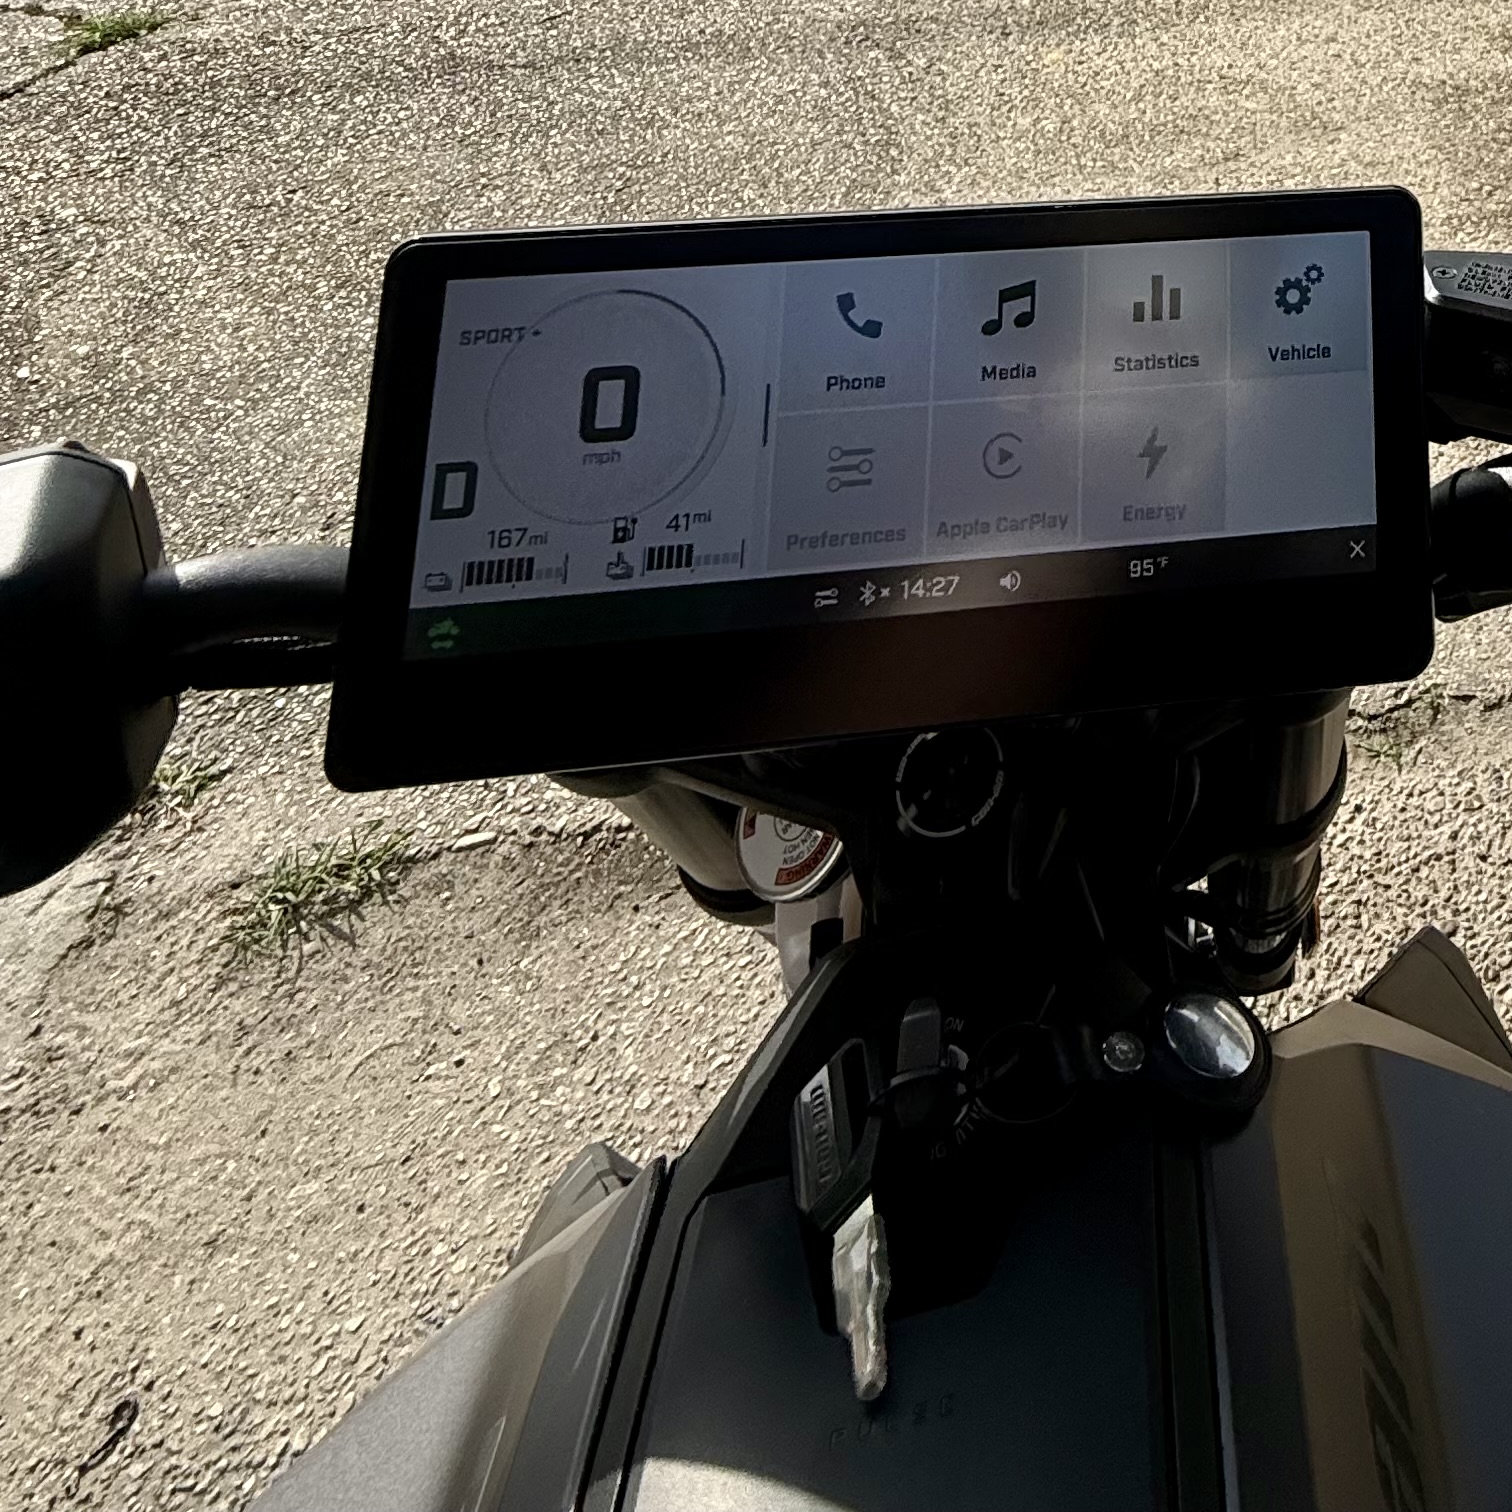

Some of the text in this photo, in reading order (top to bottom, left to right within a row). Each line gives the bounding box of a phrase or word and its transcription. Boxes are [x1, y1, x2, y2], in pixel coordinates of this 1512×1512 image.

[1113, 352, 1200, 372] Statistics
[1267, 343, 1332, 362] Vehicle
[980, 362, 1037, 381] Media
[826, 373, 886, 391] Phone
[579, 365, 641, 443] 0
[582, 449, 622, 466] mph
[429, 460, 479, 521] D
[1123, 503, 1187, 524] Energy
[936, 511, 1069, 540] Apple CarPlay
[786, 526, 907, 551] Preferences
[900, 575, 960, 600] 14:27
[783, 851, 805, 866] OPEN
